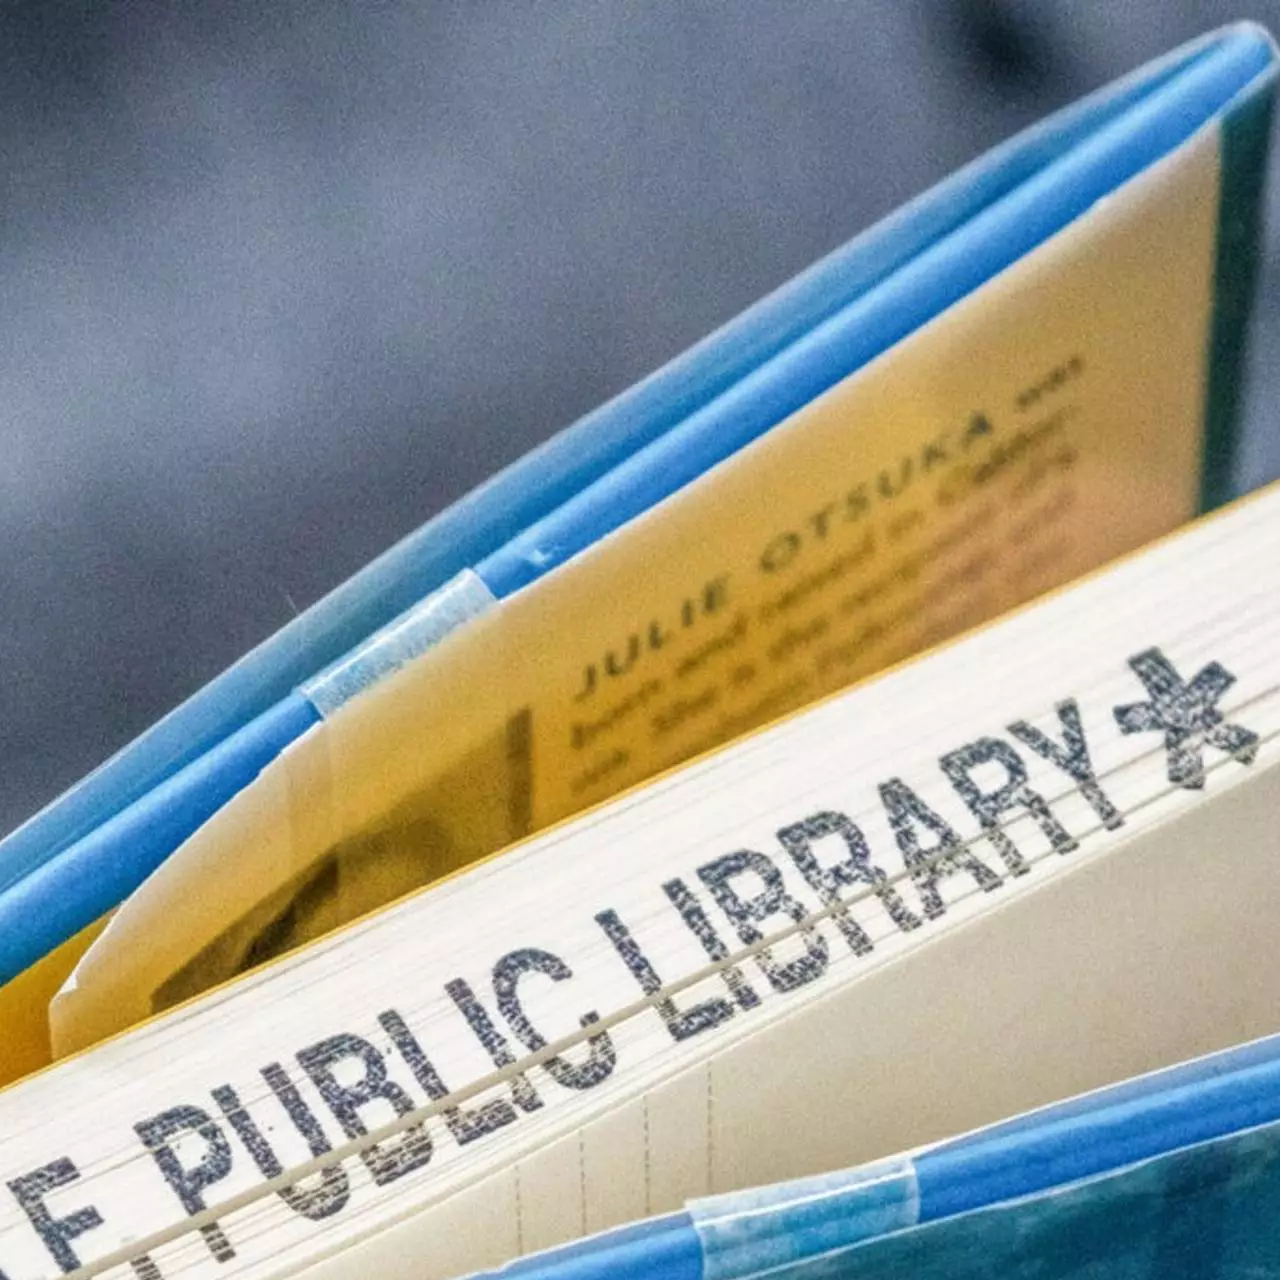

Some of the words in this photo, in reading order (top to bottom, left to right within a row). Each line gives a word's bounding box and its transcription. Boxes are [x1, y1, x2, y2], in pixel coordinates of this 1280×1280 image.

[572, 571, 731, 702] JULIE
[756, 410, 992, 576] OTSUKA
[132, 946, 618, 1263] PUBLIC
[593, 696, 1123, 1042] LIBRARY
